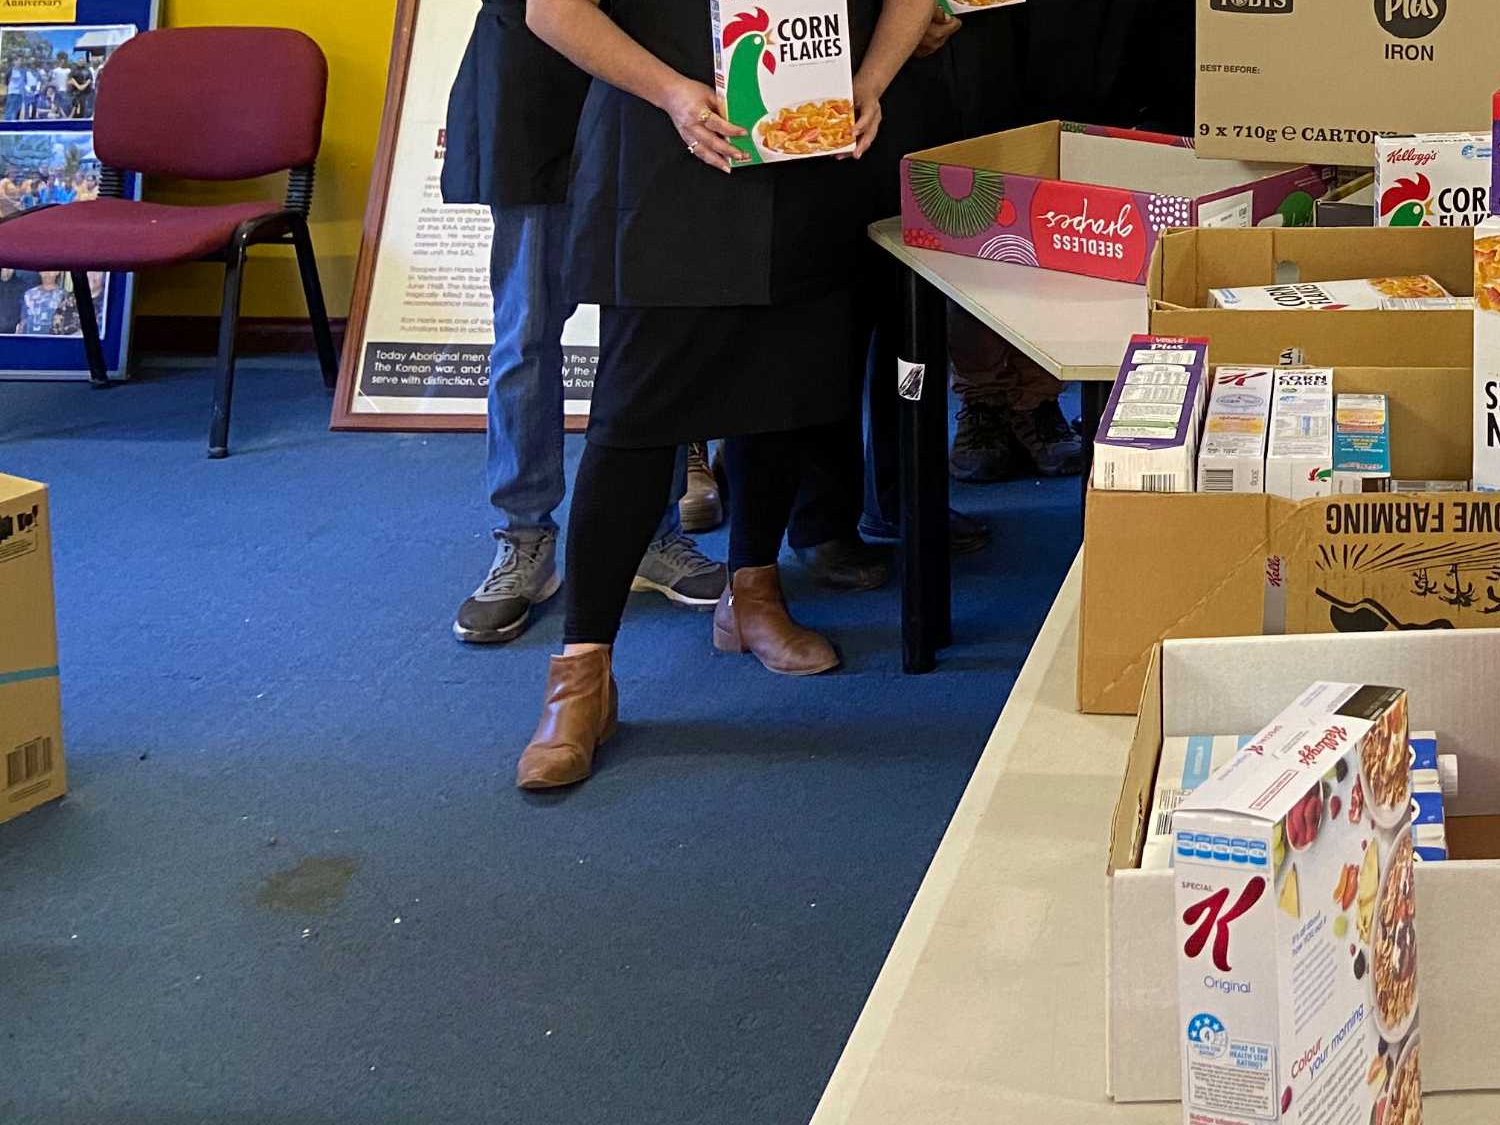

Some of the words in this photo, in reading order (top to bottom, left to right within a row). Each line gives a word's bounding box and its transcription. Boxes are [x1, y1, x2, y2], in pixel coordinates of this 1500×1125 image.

[777, 13, 840, 42] CORN
[780, 38, 842, 63] FLAKES
[1384, 43, 1434, 61] IRON
[1200, 64, 1222, 72] BEST
[1224, 65, 1261, 74] BEFORE:
[1199, 123, 1210, 136] 9
[1215, 126, 1227, 137] x
[1233, 124, 1277, 143] 710g
[1387, 147, 1439, 166] Kellogg's
[1036, 197, 1134, 238] grapes
[1053, 233, 1124, 259] SEEDLESS
[376, 349, 406, 362] Today
[409, 350, 460, 363] Aboriginal
[462, 353, 485, 362] men
[571, 353, 587, 364] the
[374, 361, 391, 372] The
[395, 362, 431, 373] Korean
[461, 363, 481, 373] and
[574, 365, 590, 375] the
[371, 375, 398, 384] serve
[401, 374, 421, 385] with
[423, 375, 475, 386] distinction.
[1326, 502, 1444, 535] FARMING
[1297, 724, 1348, 766] Kellogg's
[1181, 881, 1214, 892] SPECIAL
[1182, 875, 1266, 972] K
[1203, 975, 1251, 994] Original
[1204, 1030, 1210, 1041] 4
[1308, 1044, 1330, 1081] your
[1330, 1002, 1365, 1052] morning
[1290, 1036, 1323, 1079] Colour
